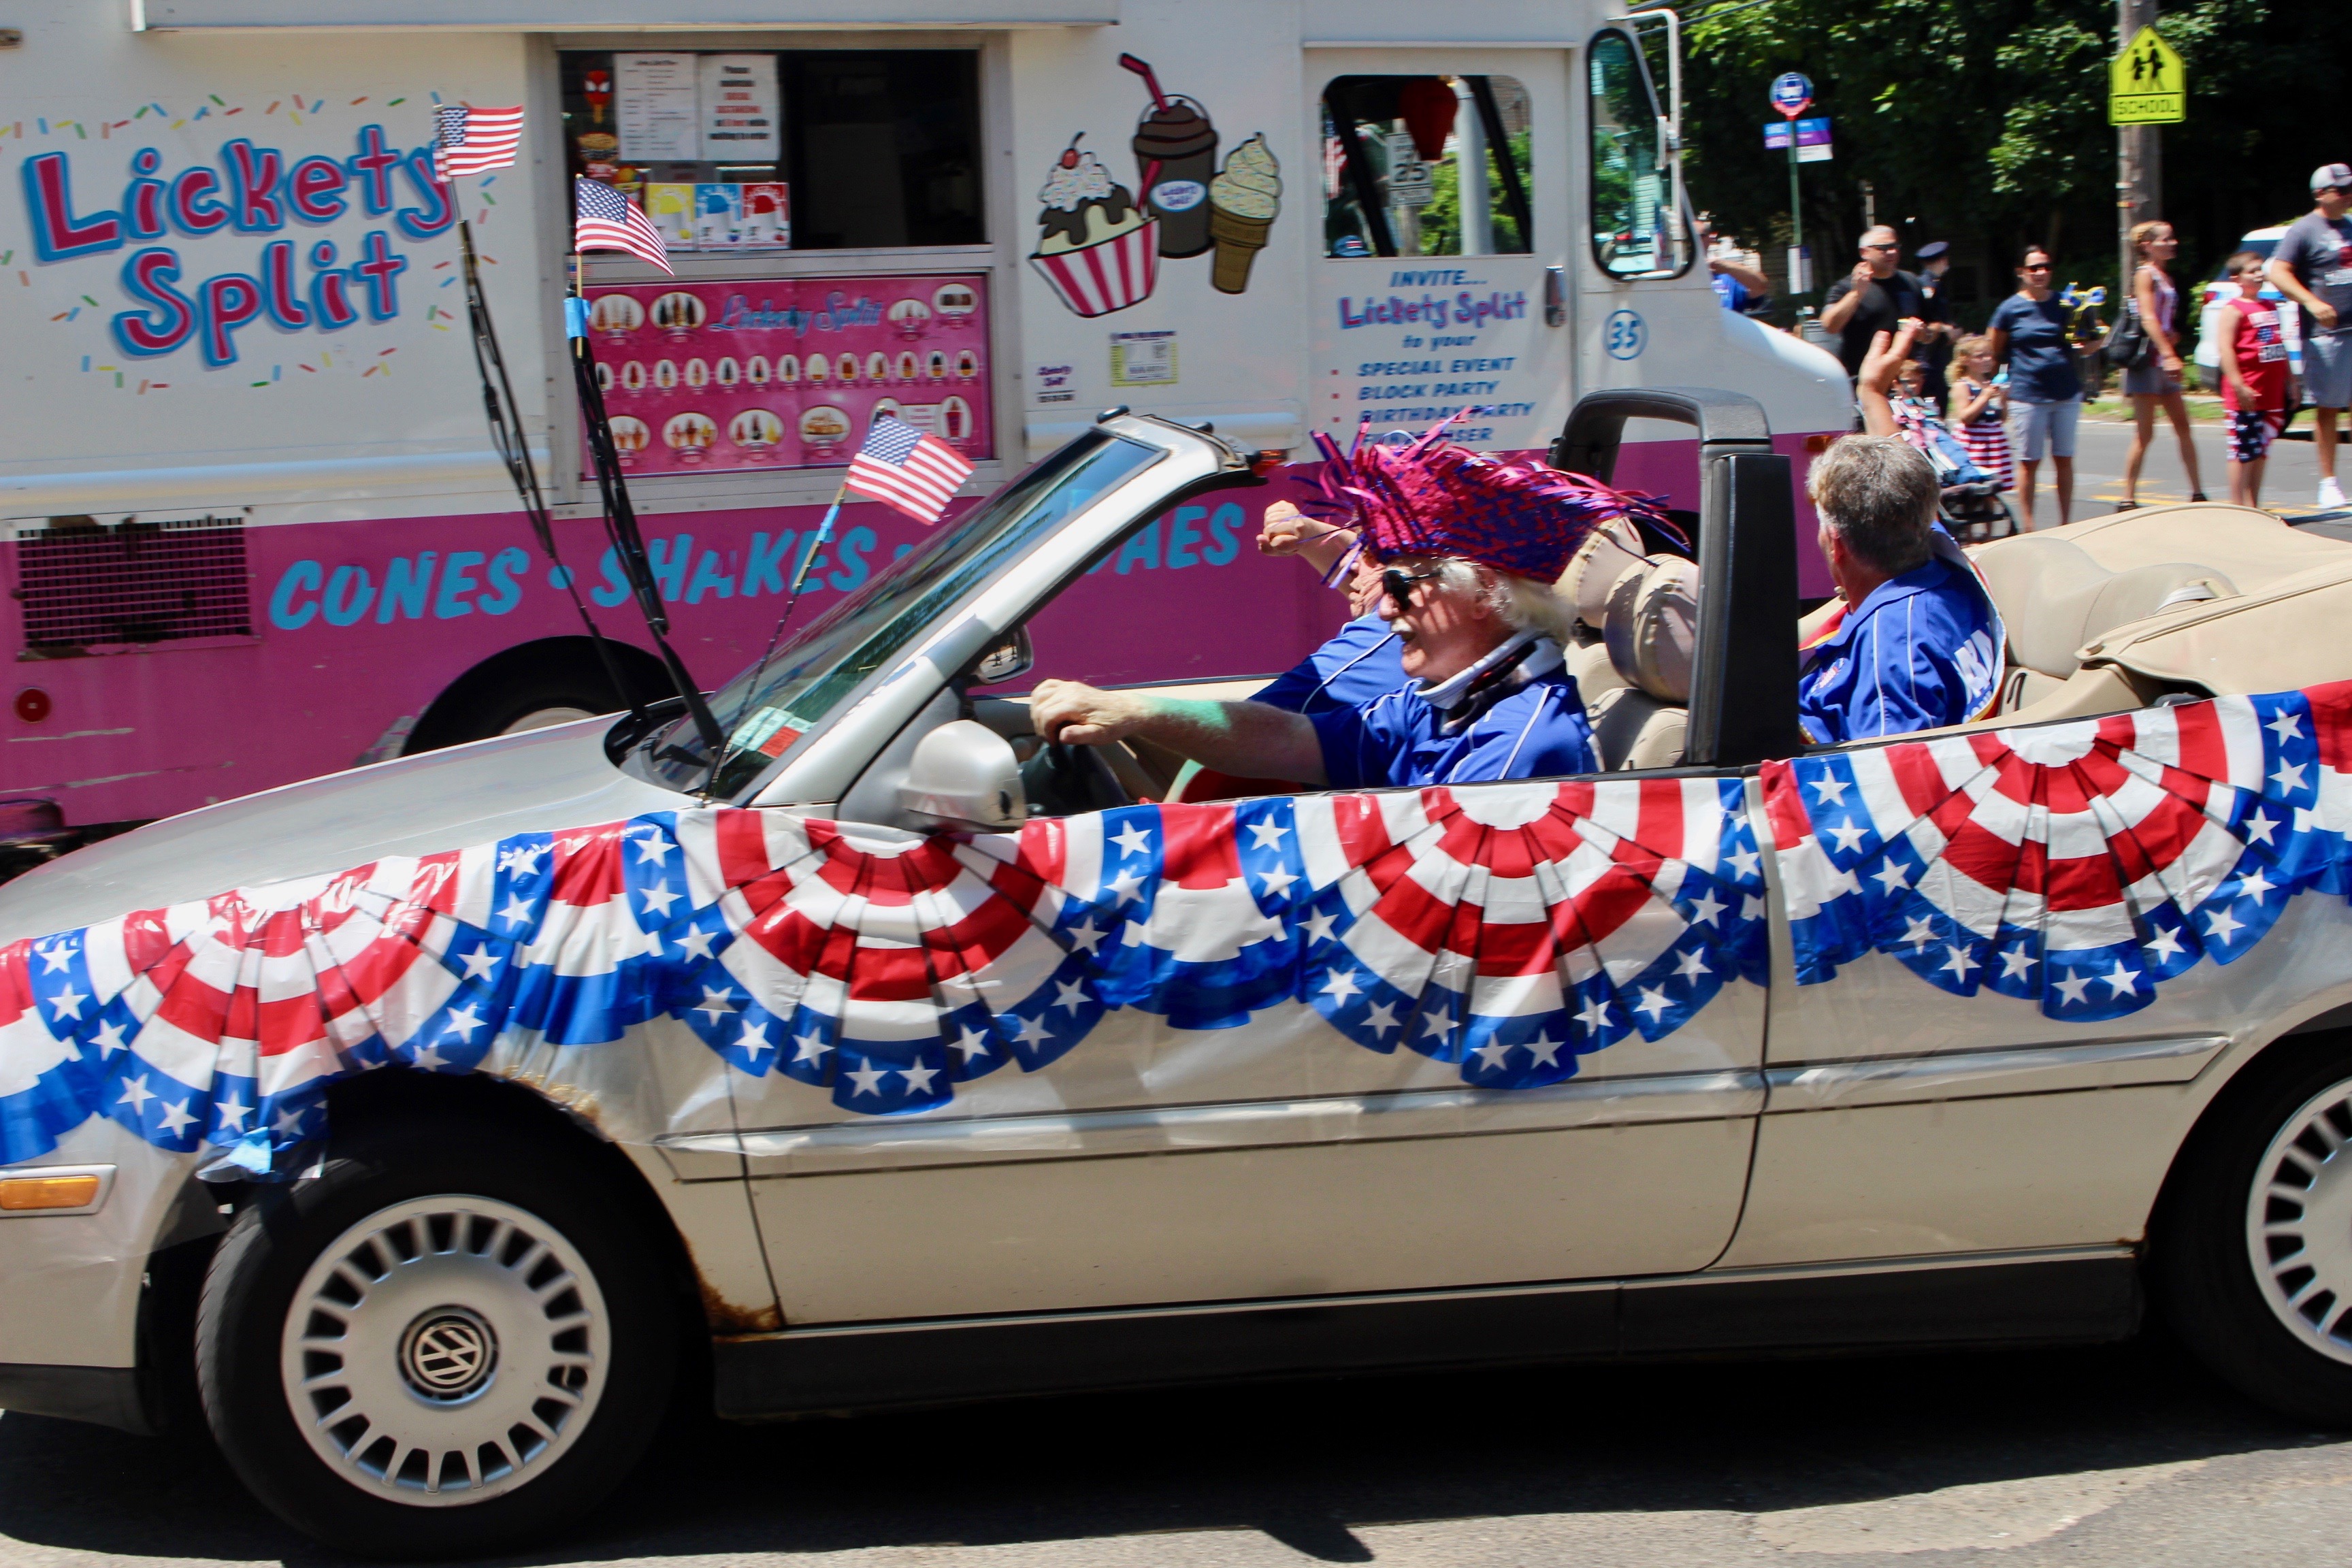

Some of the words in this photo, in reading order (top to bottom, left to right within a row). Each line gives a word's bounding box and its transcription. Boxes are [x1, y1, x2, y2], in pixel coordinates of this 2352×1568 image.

[2114, 99, 2179, 115] SCHOOL
[1394, 161, 1426, 182] 25
[22, 124, 457, 263] Lickety
[112, 230, 407, 368] Split
[1338, 293, 1450, 329] Lickety
[1453, 291, 1529, 329] Split
[1401, 334, 1424, 348] to
[1430, 335, 1478, 352] your
[1607, 319, 1641, 350] 35
[1356, 359, 1444, 377] SPECIAL
[1450, 357, 1517, 374] EVENT
[1357, 384, 1429, 401] BLOCK
[1431, 380, 1501, 397] PARTY
[270, 546, 530, 630] CONES
[589, 525, 879, 607] SHAKES
